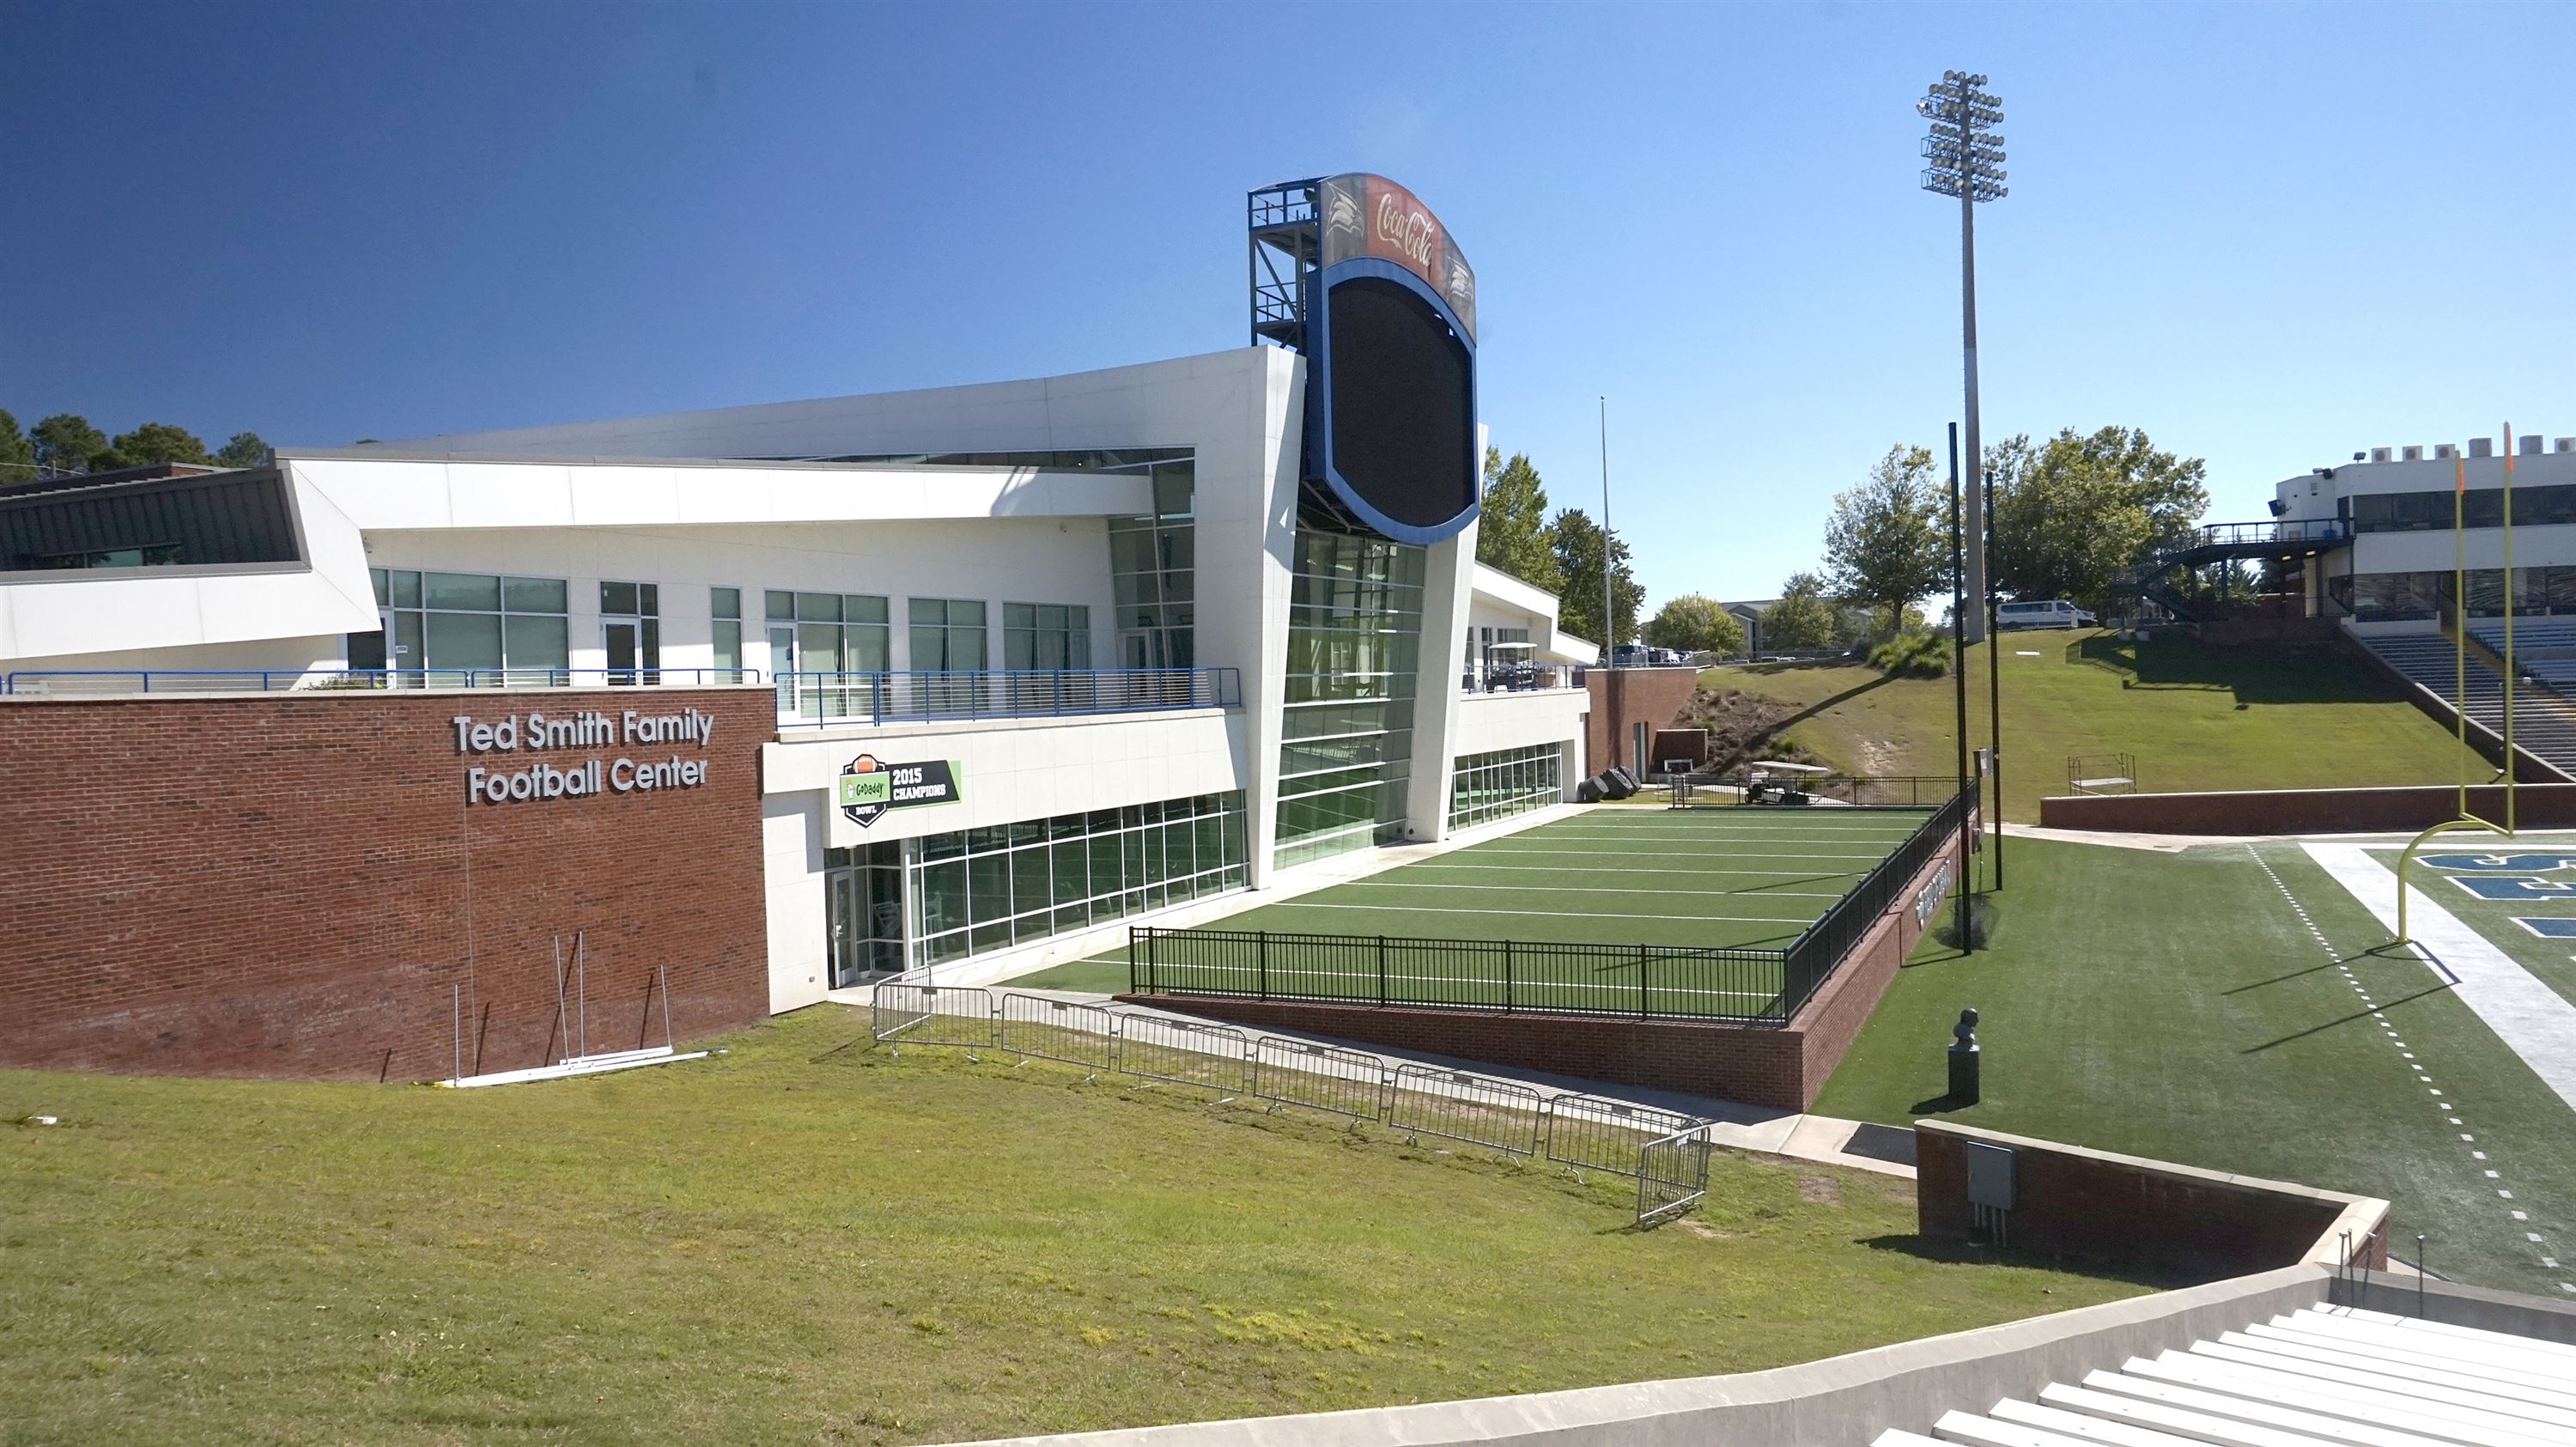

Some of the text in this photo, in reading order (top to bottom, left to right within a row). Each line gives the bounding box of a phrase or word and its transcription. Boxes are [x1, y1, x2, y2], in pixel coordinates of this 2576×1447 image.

[453, 708, 714, 751] Ted Smith Family
[469, 756, 708, 804] Football Center
[892, 767, 922, 786] 2015
[855, 782, 884, 798] GoDaddy
[893, 784, 946, 800] CHAMPIONS
[855, 805, 877, 815] BOWL
